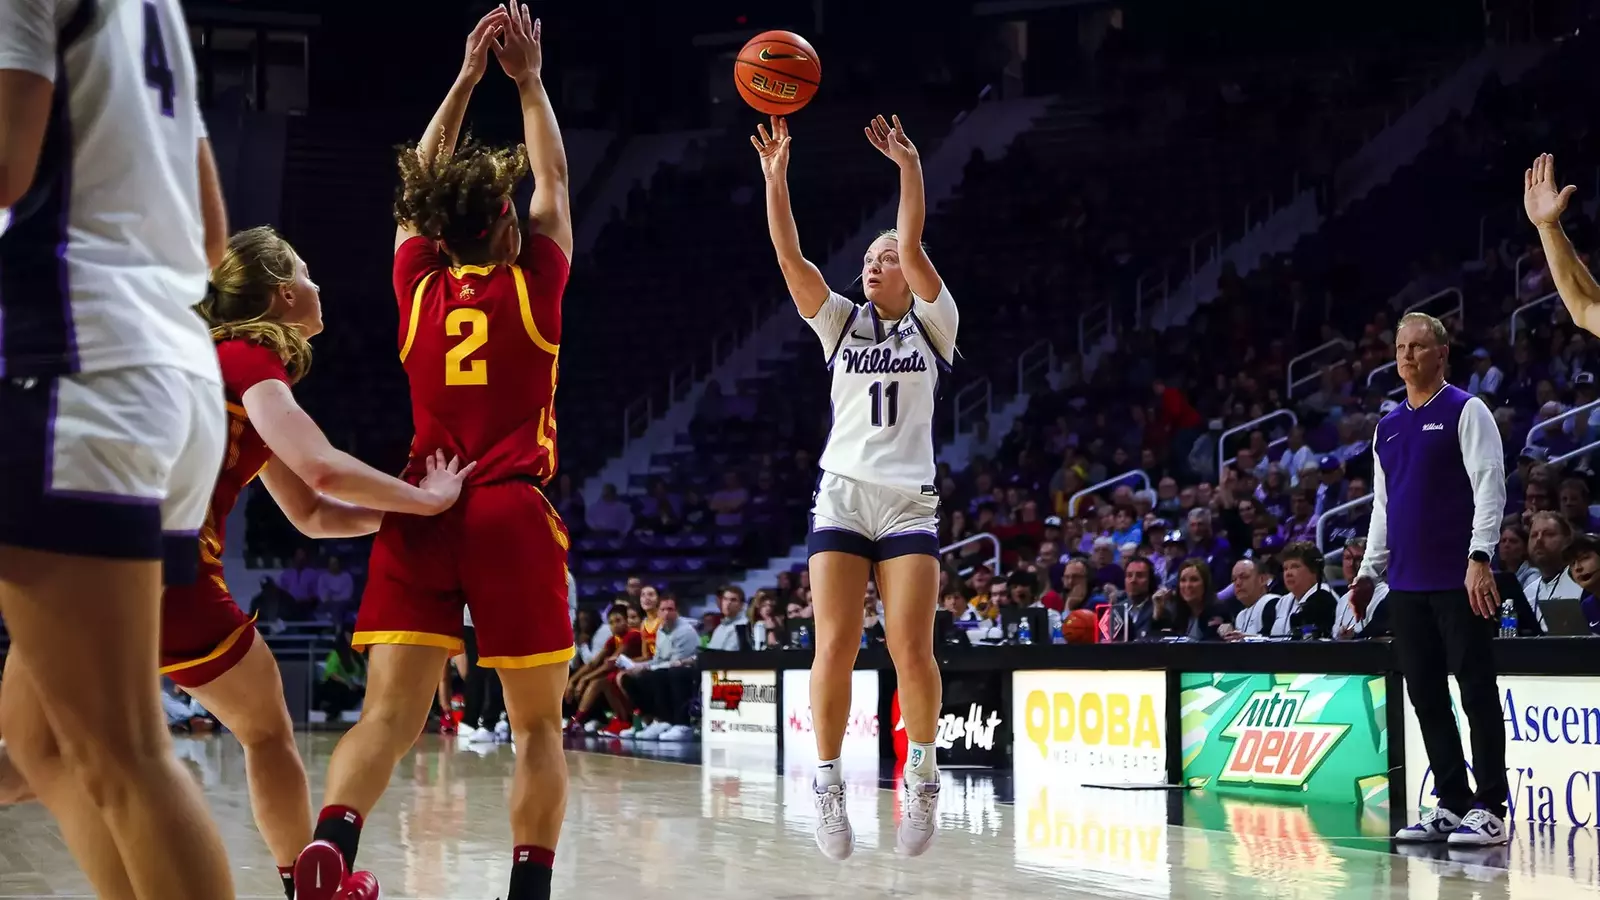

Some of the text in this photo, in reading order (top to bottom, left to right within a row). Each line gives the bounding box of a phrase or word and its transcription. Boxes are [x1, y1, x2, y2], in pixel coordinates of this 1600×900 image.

[143, 1, 176, 118] 4
[751, 72, 798, 96] ELITE
[445, 308, 488, 385] 2
[842, 347, 927, 374] Wildcats
[868, 381, 899, 427] 11
[965, 703, 1002, 750] Hut
[1025, 689, 1161, 760] QDOBA
[1237, 692, 1297, 728] Mtn
[1502, 688, 1600, 745] Ascen
[1506, 767, 1557, 824] Via
